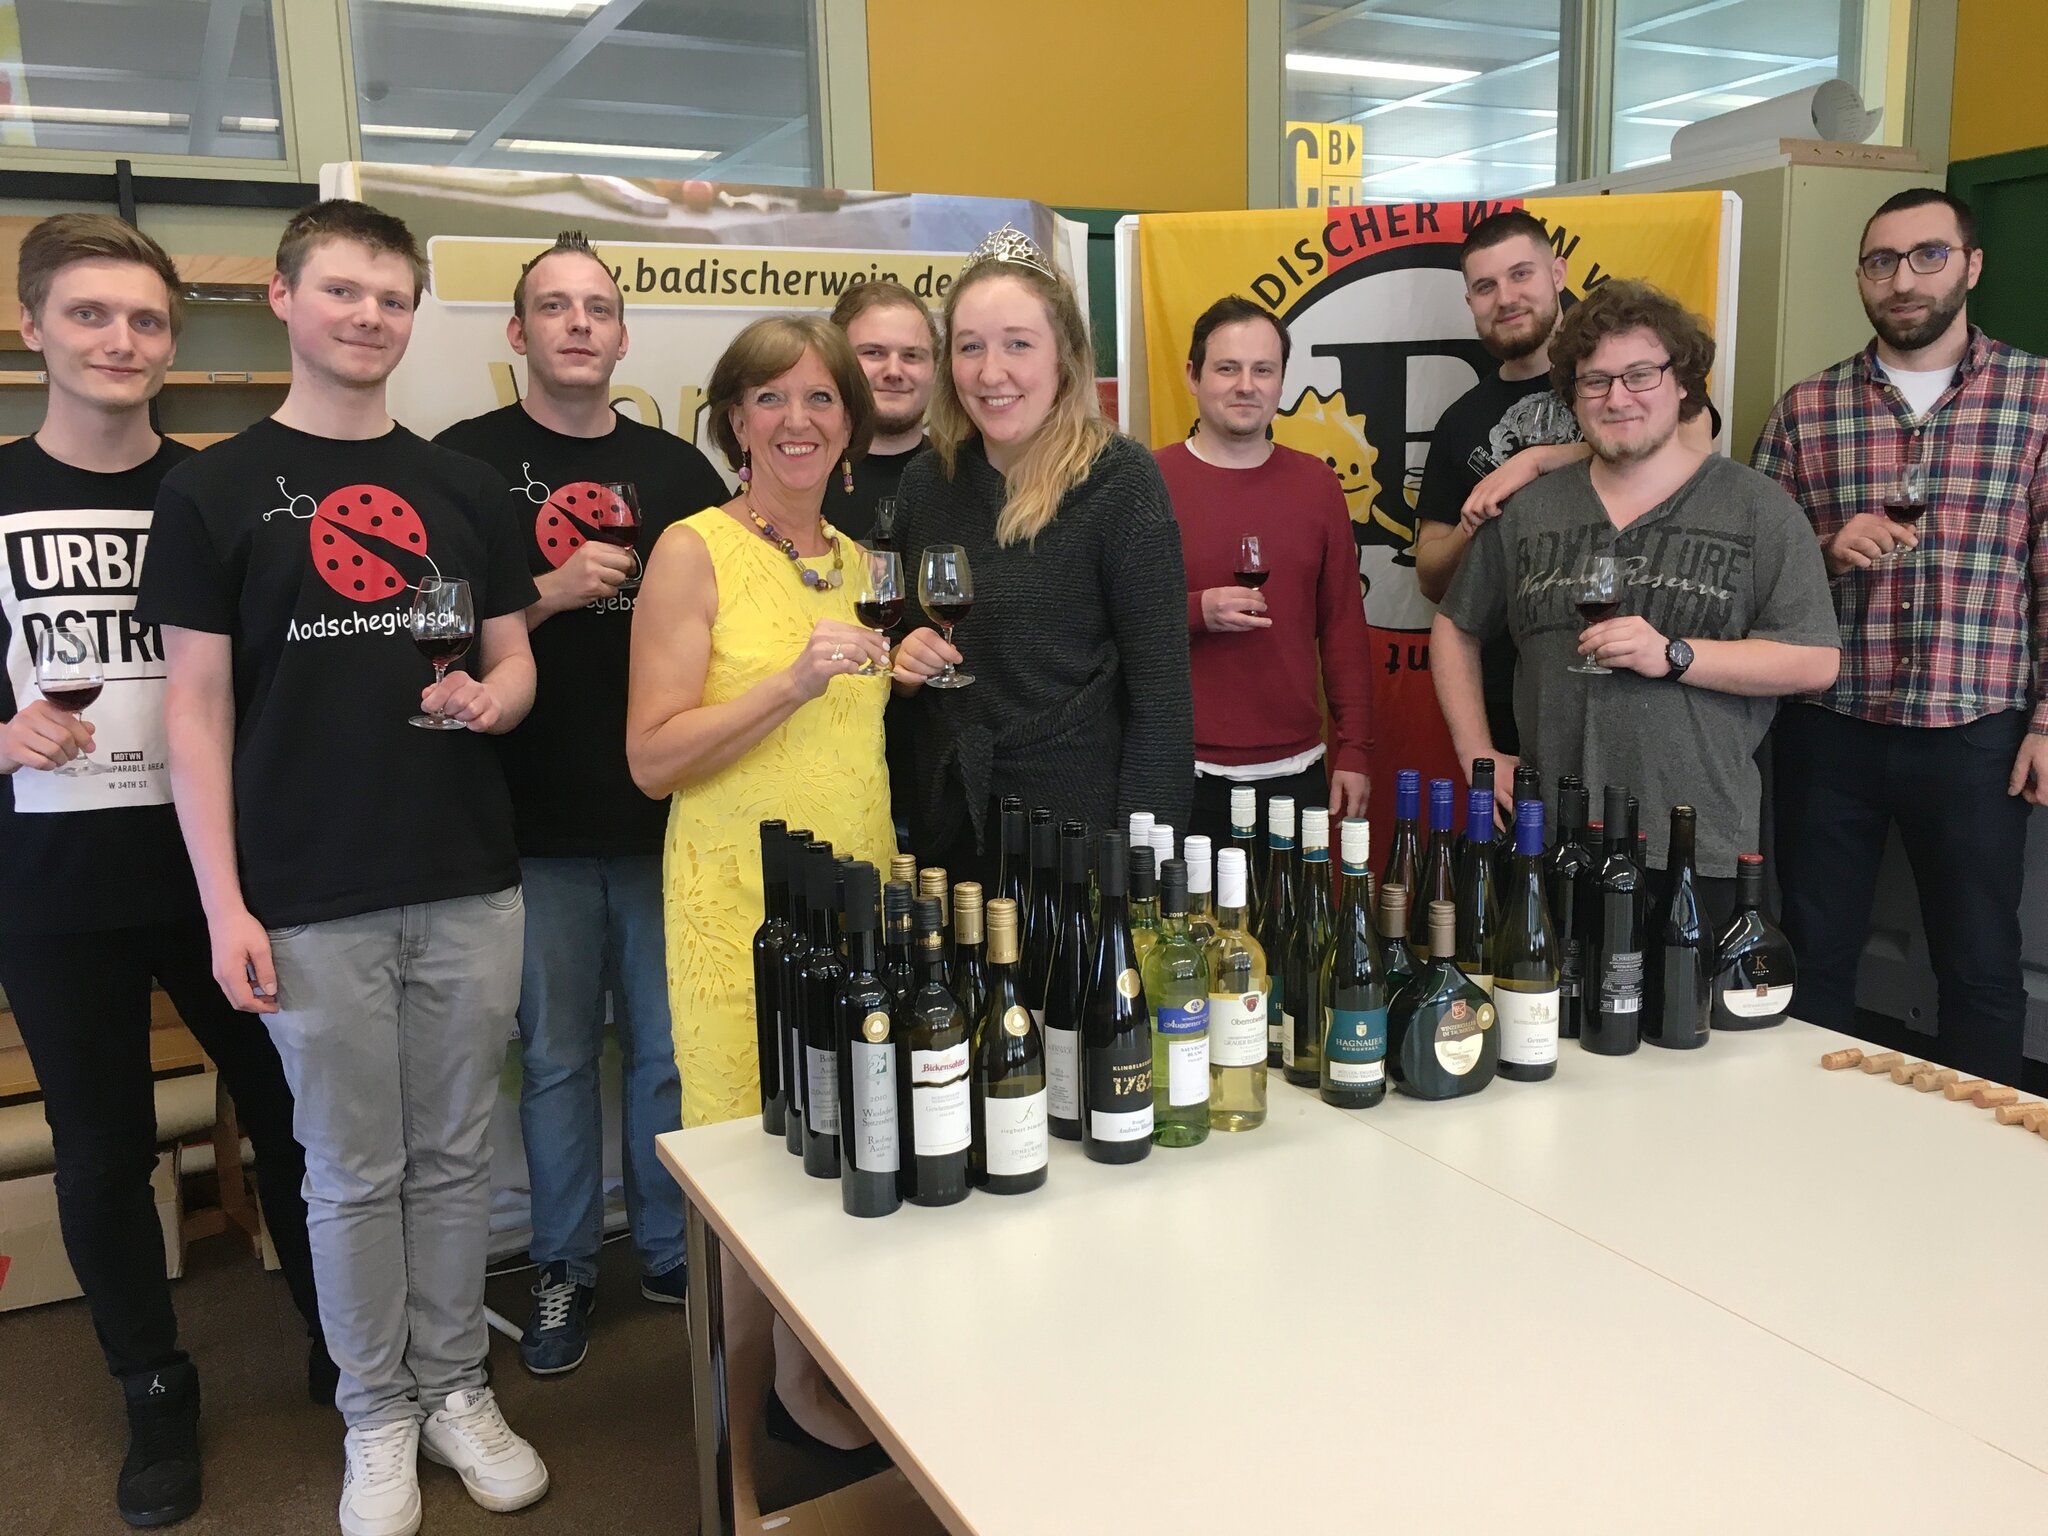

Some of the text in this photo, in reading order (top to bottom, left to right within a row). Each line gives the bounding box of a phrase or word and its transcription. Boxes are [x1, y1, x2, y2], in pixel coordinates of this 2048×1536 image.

[1328, 129, 1342, 165] B
[1250, 202, 1440, 310] DISCHER
[111, 764, 146, 774] PARABLE
[118, 781, 136, 790] 34TH
[1755, 955, 1768, 970] K
